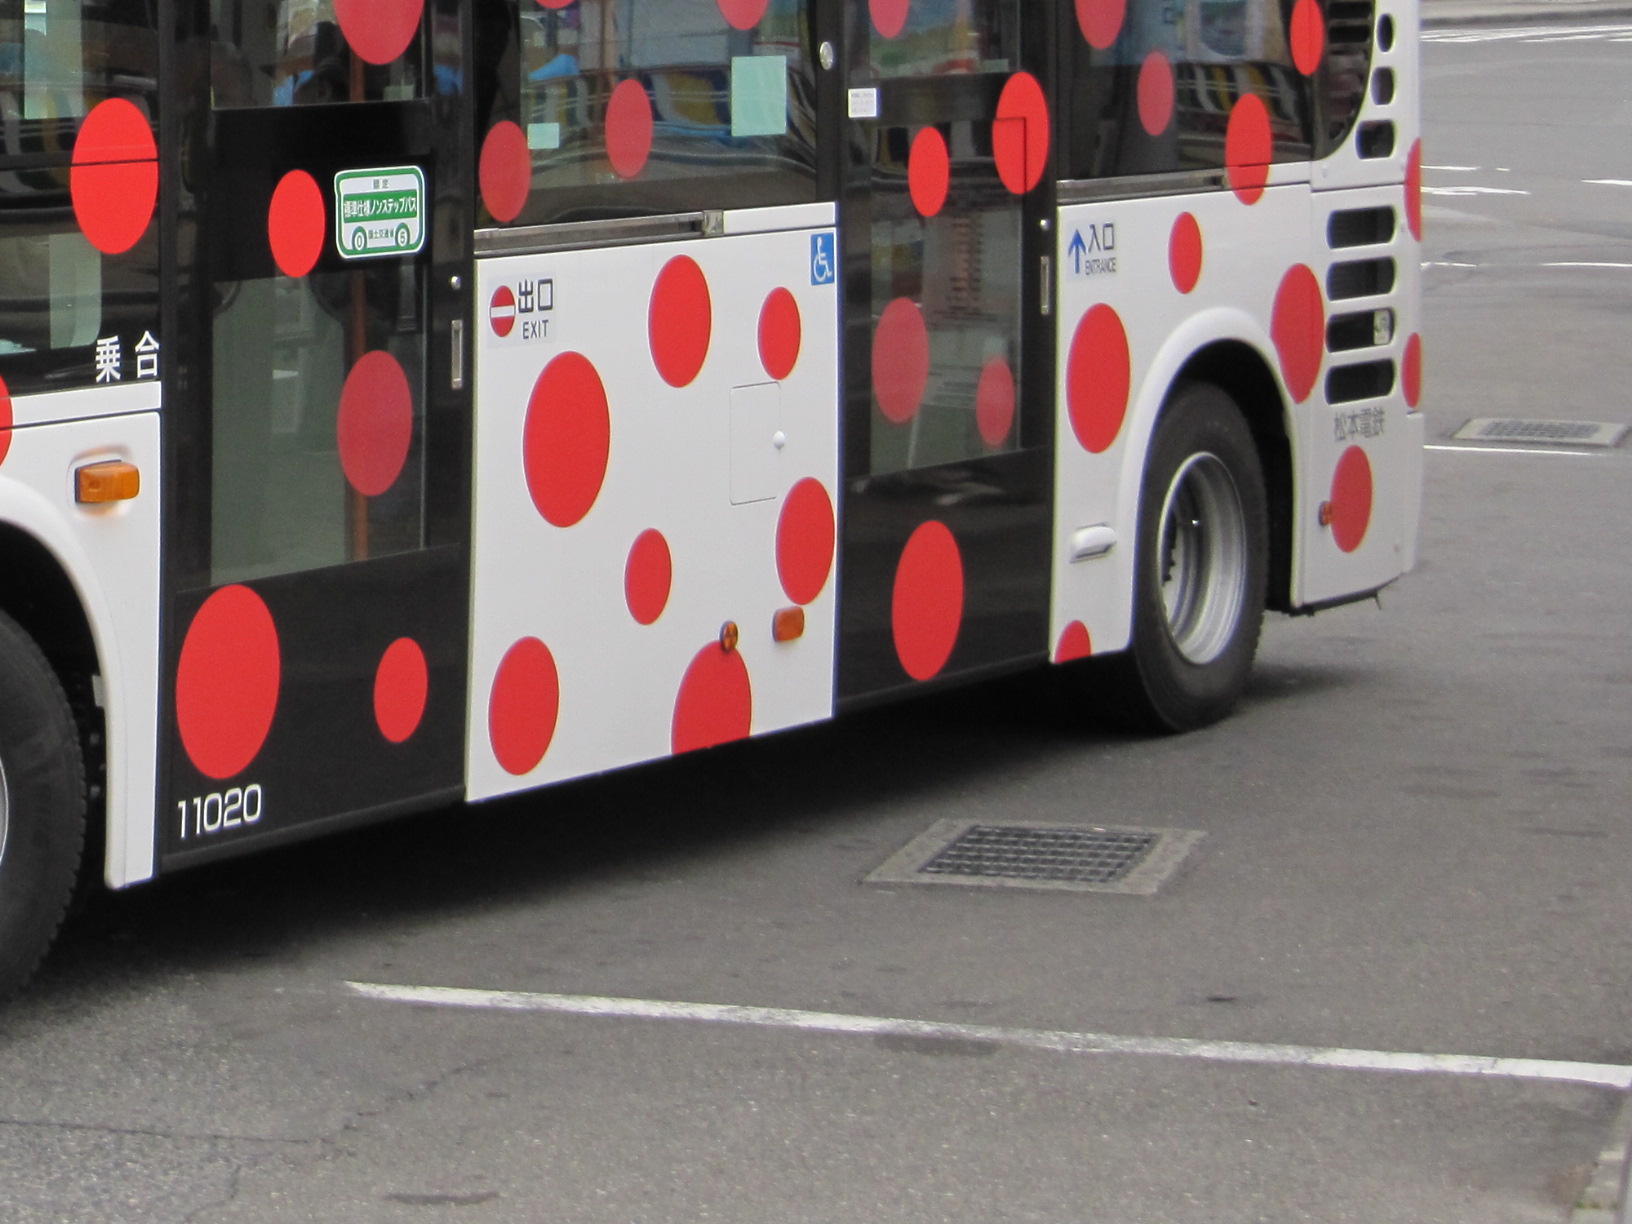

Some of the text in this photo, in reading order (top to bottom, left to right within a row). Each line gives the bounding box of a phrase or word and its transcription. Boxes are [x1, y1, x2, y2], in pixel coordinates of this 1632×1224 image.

[1088, 223, 1115, 253] 入口
[518, 278, 554, 314] 出口
[522, 320, 549, 340] EXIT
[95, 330, 161, 383] 乗合
[1333, 407, 1386, 443] 松本電鉄
[177, 783, 262, 838] 11020
